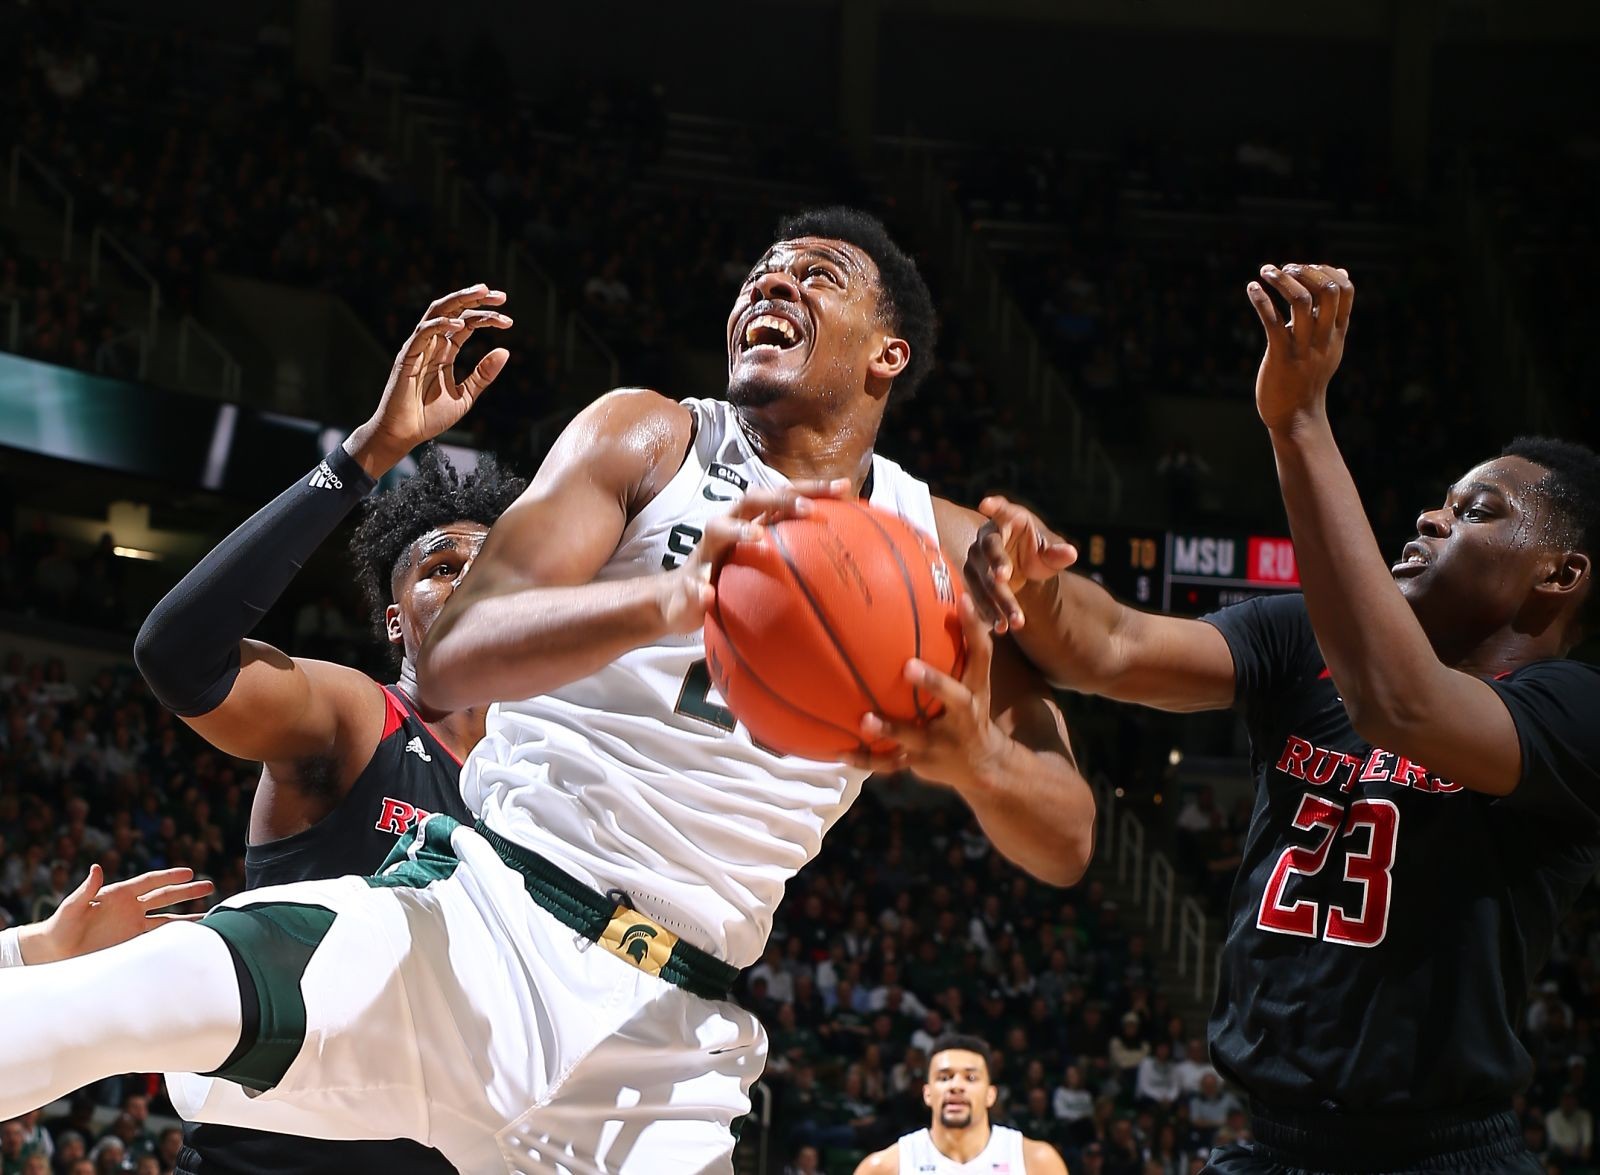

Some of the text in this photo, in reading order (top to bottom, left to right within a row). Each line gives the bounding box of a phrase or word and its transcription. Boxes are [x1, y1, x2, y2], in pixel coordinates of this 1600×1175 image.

[661, 523, 703, 571] S
[1174, 536, 1235, 577] MSU
[1257, 541, 1295, 580] RU
[1256, 792, 1400, 948] 23
